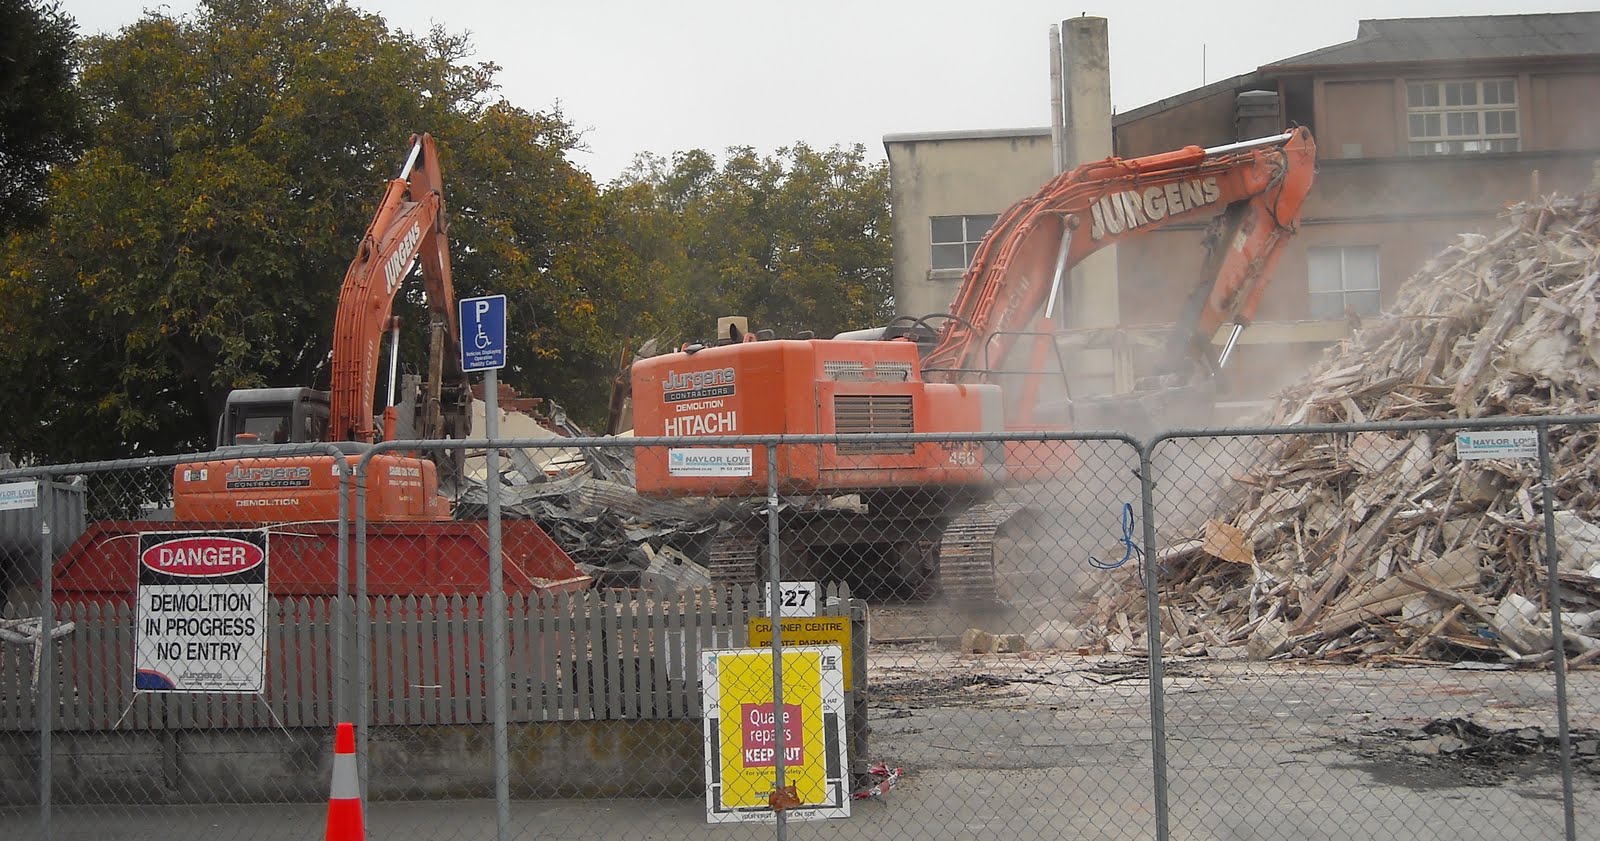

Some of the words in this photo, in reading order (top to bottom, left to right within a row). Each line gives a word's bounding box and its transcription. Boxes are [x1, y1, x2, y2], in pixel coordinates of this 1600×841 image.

[1089, 177, 1220, 240] JURGENS
[384, 220, 421, 295] JURGENS
[476, 300, 490, 323] P
[364, 339, 374, 407] HITACHI
[662, 367, 735, 391] Jurgens
[671, 387, 728, 400] CONTRACTORS
[676, 400, 724, 412] DEMOLITION
[664, 411, 737, 437] HITACHI
[226, 465, 311, 481] Jurgens
[235, 480, 302, 488] CONTRACTORS
[236, 499, 299, 507] DEMOLITION
[159, 547, 246, 567] DANGER
[151, 593, 252, 612] DEMOLITION
[146, 618, 161, 636] IN
[166, 617, 256, 637] PROGRESS
[805, 622, 843, 632] CENTRE
[157, 642, 181, 660] NO
[186, 642, 242, 660] ENTRY
[750, 709, 790, 727] Quae
[746, 748, 774, 762] KEEP
